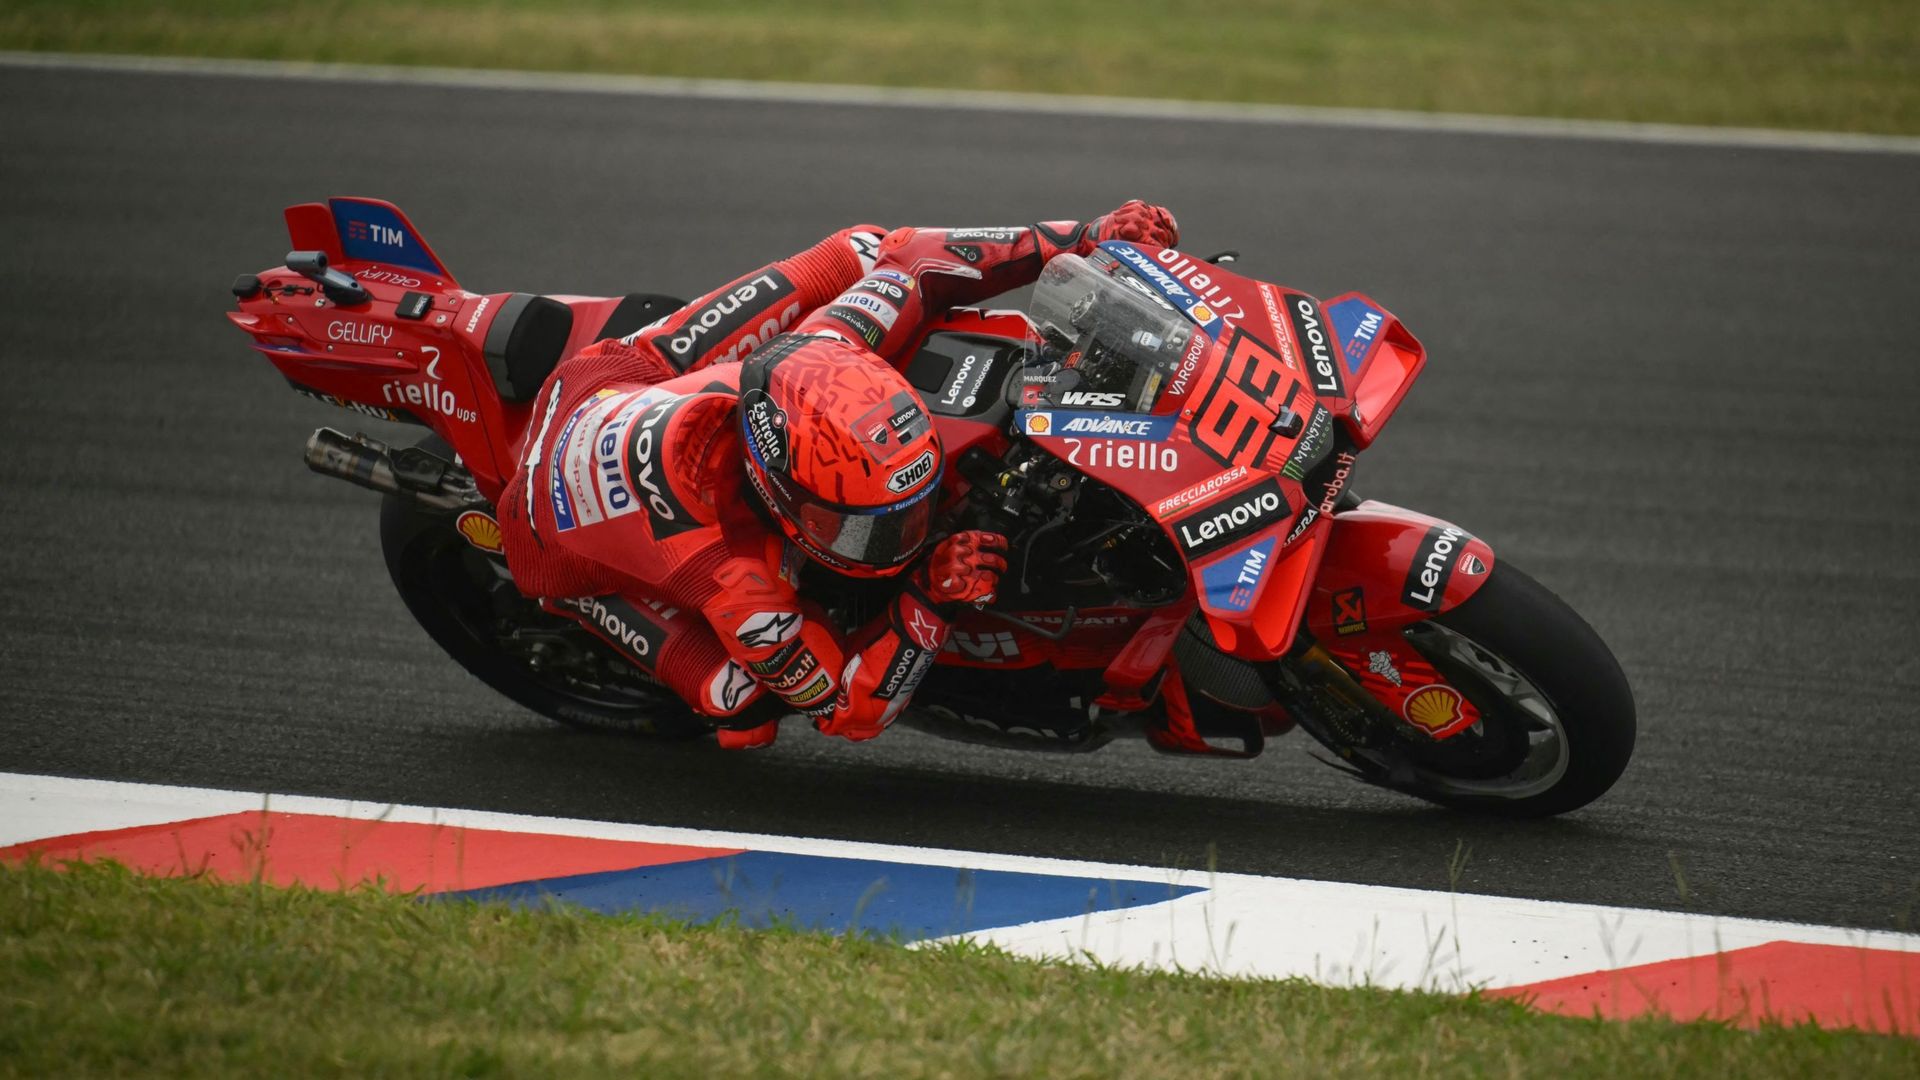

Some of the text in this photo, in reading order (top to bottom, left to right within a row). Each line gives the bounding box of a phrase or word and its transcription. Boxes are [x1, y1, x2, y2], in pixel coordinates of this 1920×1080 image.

[370, 224, 403, 248] TIM
[953, 231, 1015, 240] Lenovo
[355, 268, 421, 288] GELLIFY
[1115, 246, 1190, 297] ADVANCE
[1157, 248, 1232, 308] riello
[465, 297, 490, 333] DUCATI
[670, 274, 779, 355] Lenovo
[840, 295, 881, 313] riello
[1261, 284, 1297, 370] FRECCIAROSSA
[1354, 312, 1383, 341] TIM
[327, 320, 393, 345] GELLIFY
[707, 301, 800, 367] DUCA
[1298, 300, 1337, 392] Lenovo
[941, 355, 976, 405] Lenovo
[971, 358, 993, 395] motorola
[1023, 375, 1057, 383] MARQUEZ
[1061, 391, 1126, 407] WRS
[382, 380, 455, 416] riello
[456, 408, 477, 423] ups
[748, 409, 770, 462] Galicia
[753, 401, 780, 458] Estrella
[1062, 418, 1153, 435] ADVANCE
[1294, 407, 1330, 464] MONSTER
[636, 398, 675, 521] novo
[895, 454, 932, 490] SHOEI
[1089, 440, 1178, 471] riello
[1158, 466, 1248, 514] FRECCIAROSSA
[1319, 452, 1355, 514] aruba.it
[1181, 492, 1279, 548] Lenovo
[1238, 549, 1266, 585] TIM
[1410, 528, 1463, 604] Lenovo
[878, 648, 915, 697] Lenovo
